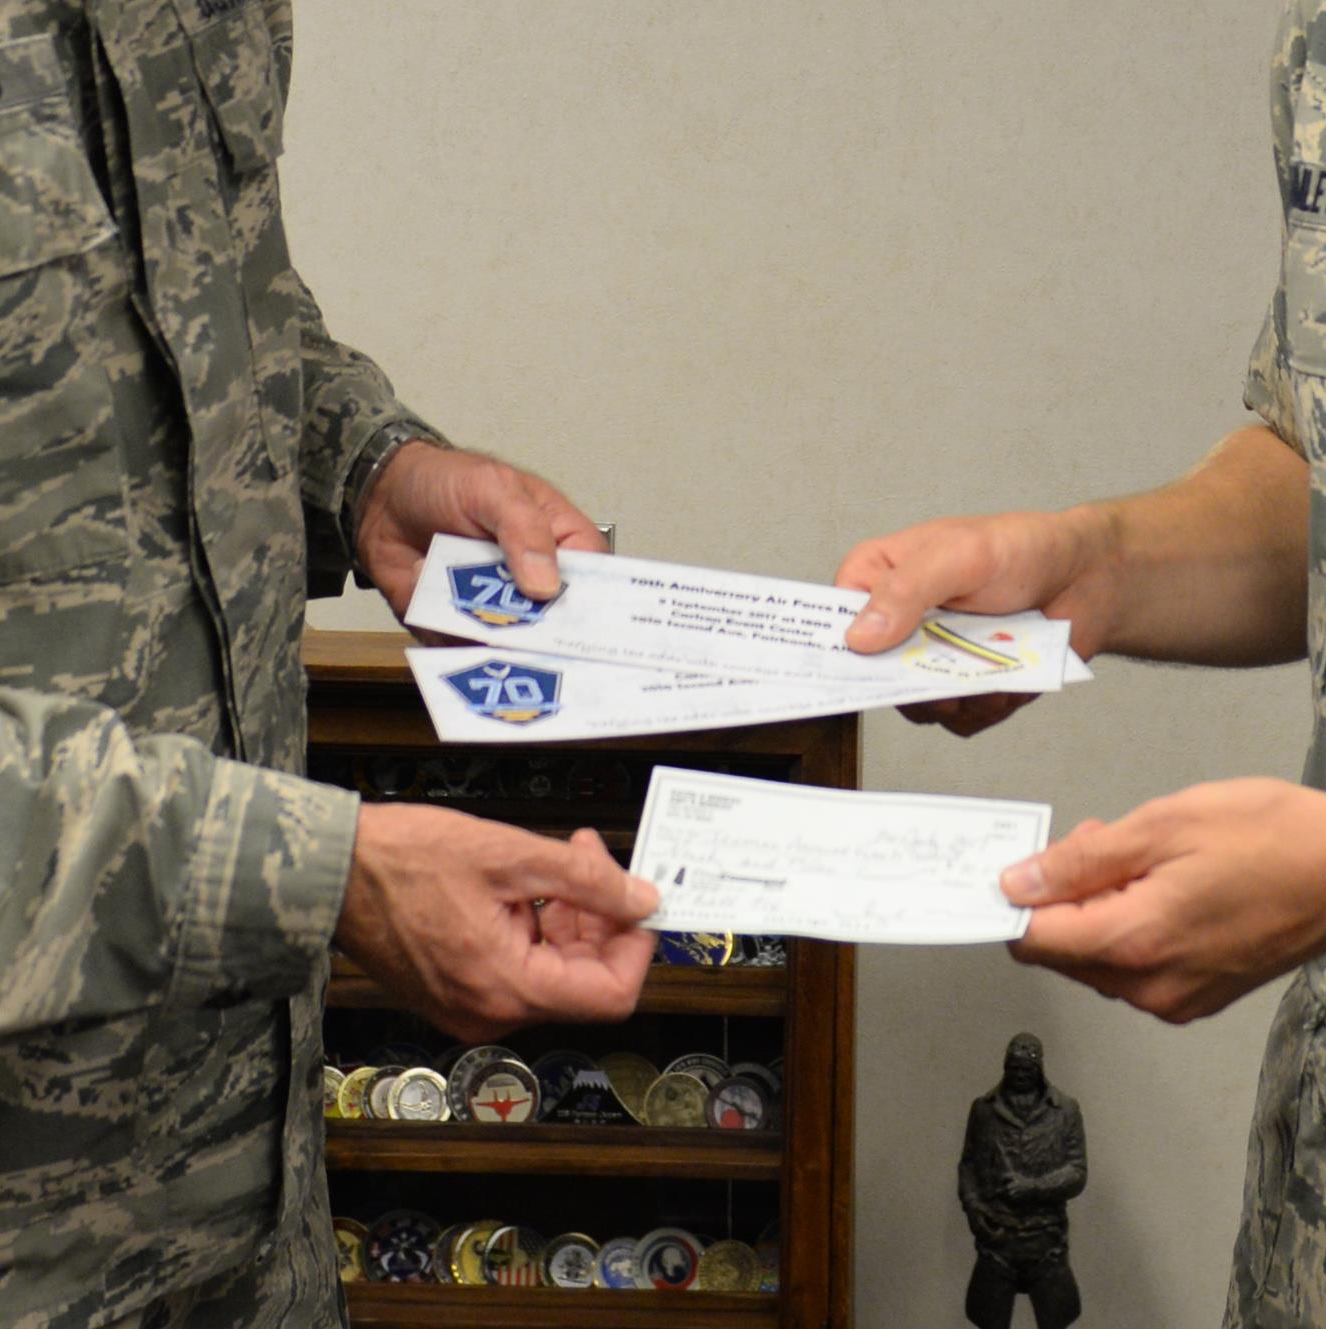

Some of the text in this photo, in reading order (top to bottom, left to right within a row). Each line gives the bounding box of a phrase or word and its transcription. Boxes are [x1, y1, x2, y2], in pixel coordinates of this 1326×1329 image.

[669, 581, 761, 603] Anniversary
[765, 594, 788, 606] Air
[792, 599, 833, 614] Force
[671, 598, 743, 617] September
[726, 617, 765, 631] Event
[769, 623, 815, 637] Center
[468, 675, 543, 708] 70
